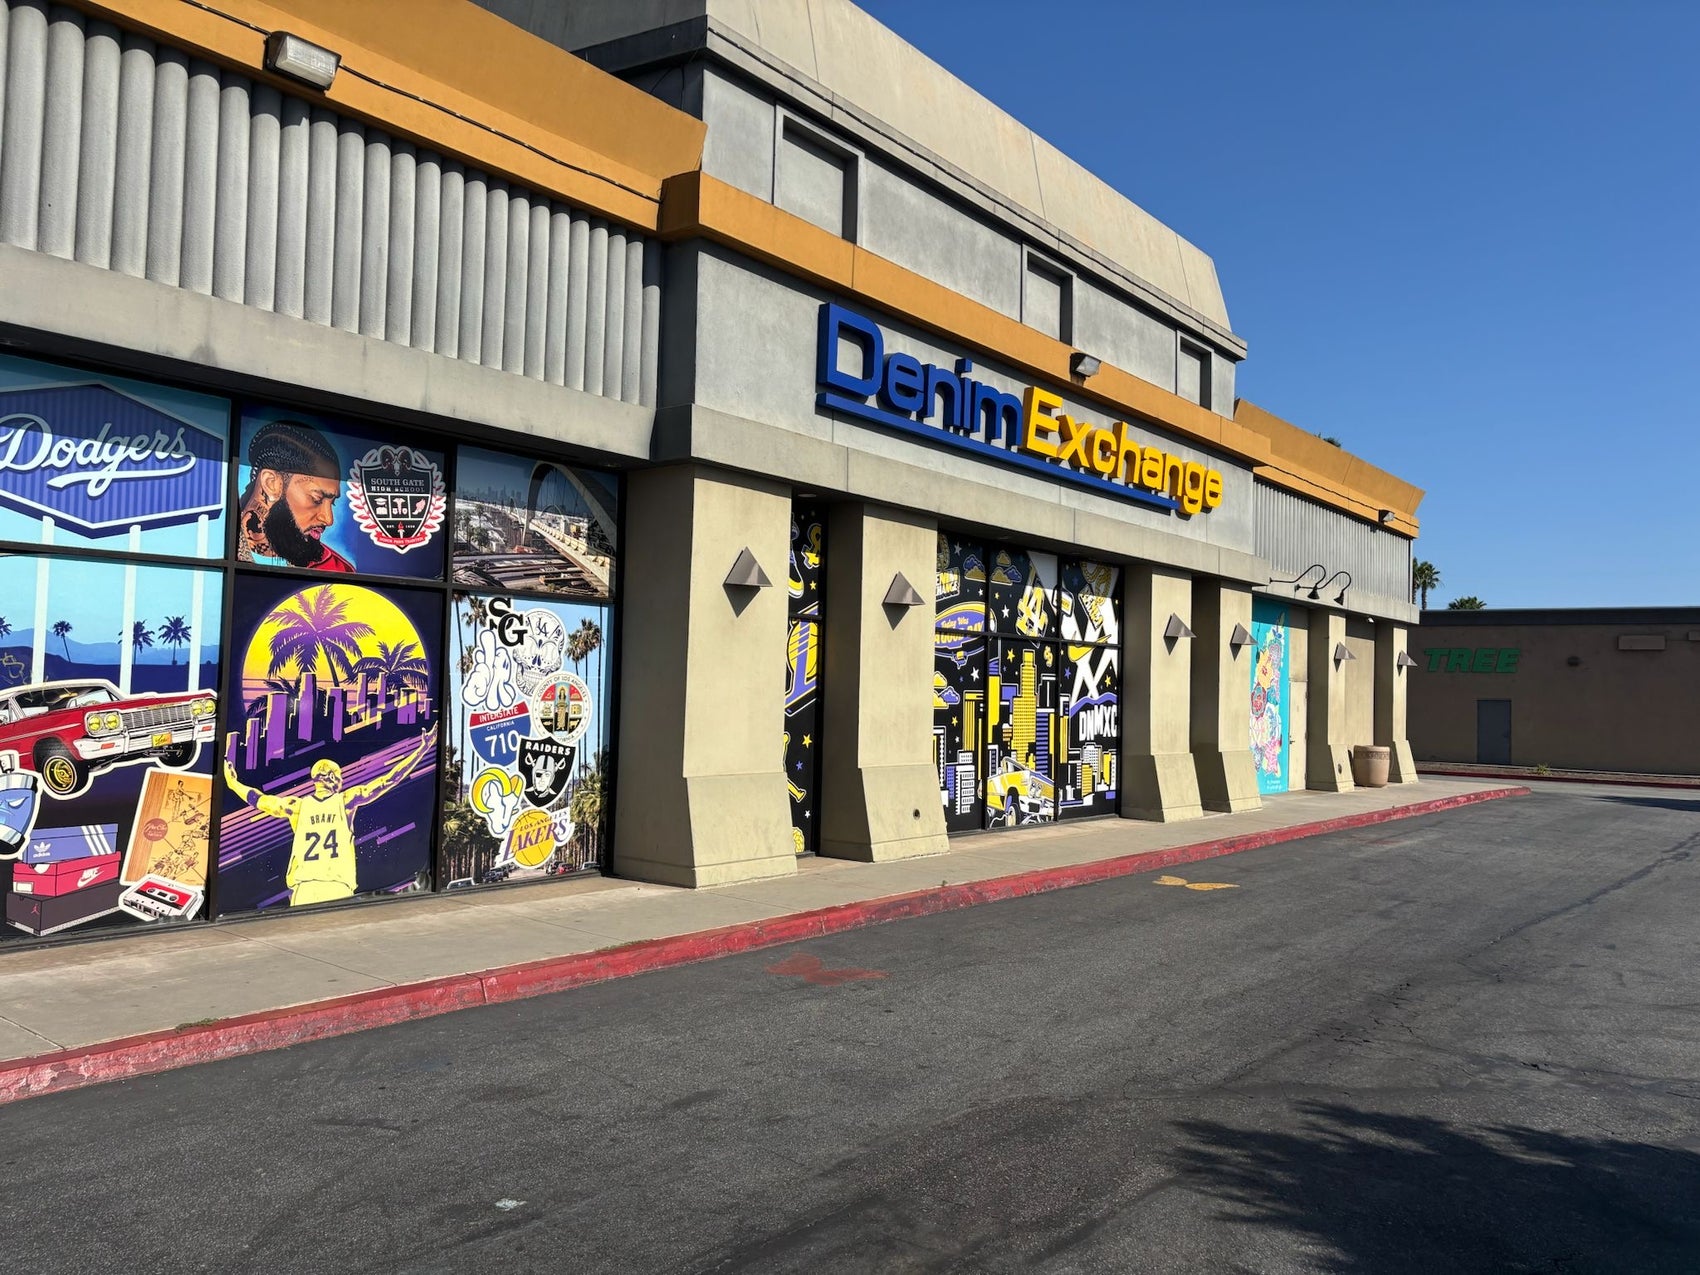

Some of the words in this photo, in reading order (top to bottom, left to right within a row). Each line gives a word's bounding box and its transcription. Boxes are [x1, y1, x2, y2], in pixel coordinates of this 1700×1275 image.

[0, 413, 196, 497] Dodgers
[371, 478, 400, 486] SOUTH
[402, 479, 425, 487] GATE
[1424, 648, 1521, 673] TREE
[479, 706, 519, 722] INTERSTATE
[486, 720, 515, 731] CALIFORNIA
[485, 729, 519, 757] 710
[525, 741, 571, 756] RAIDERS
[304, 829, 338, 861] 24
[503, 818, 567, 861] LAKERS
